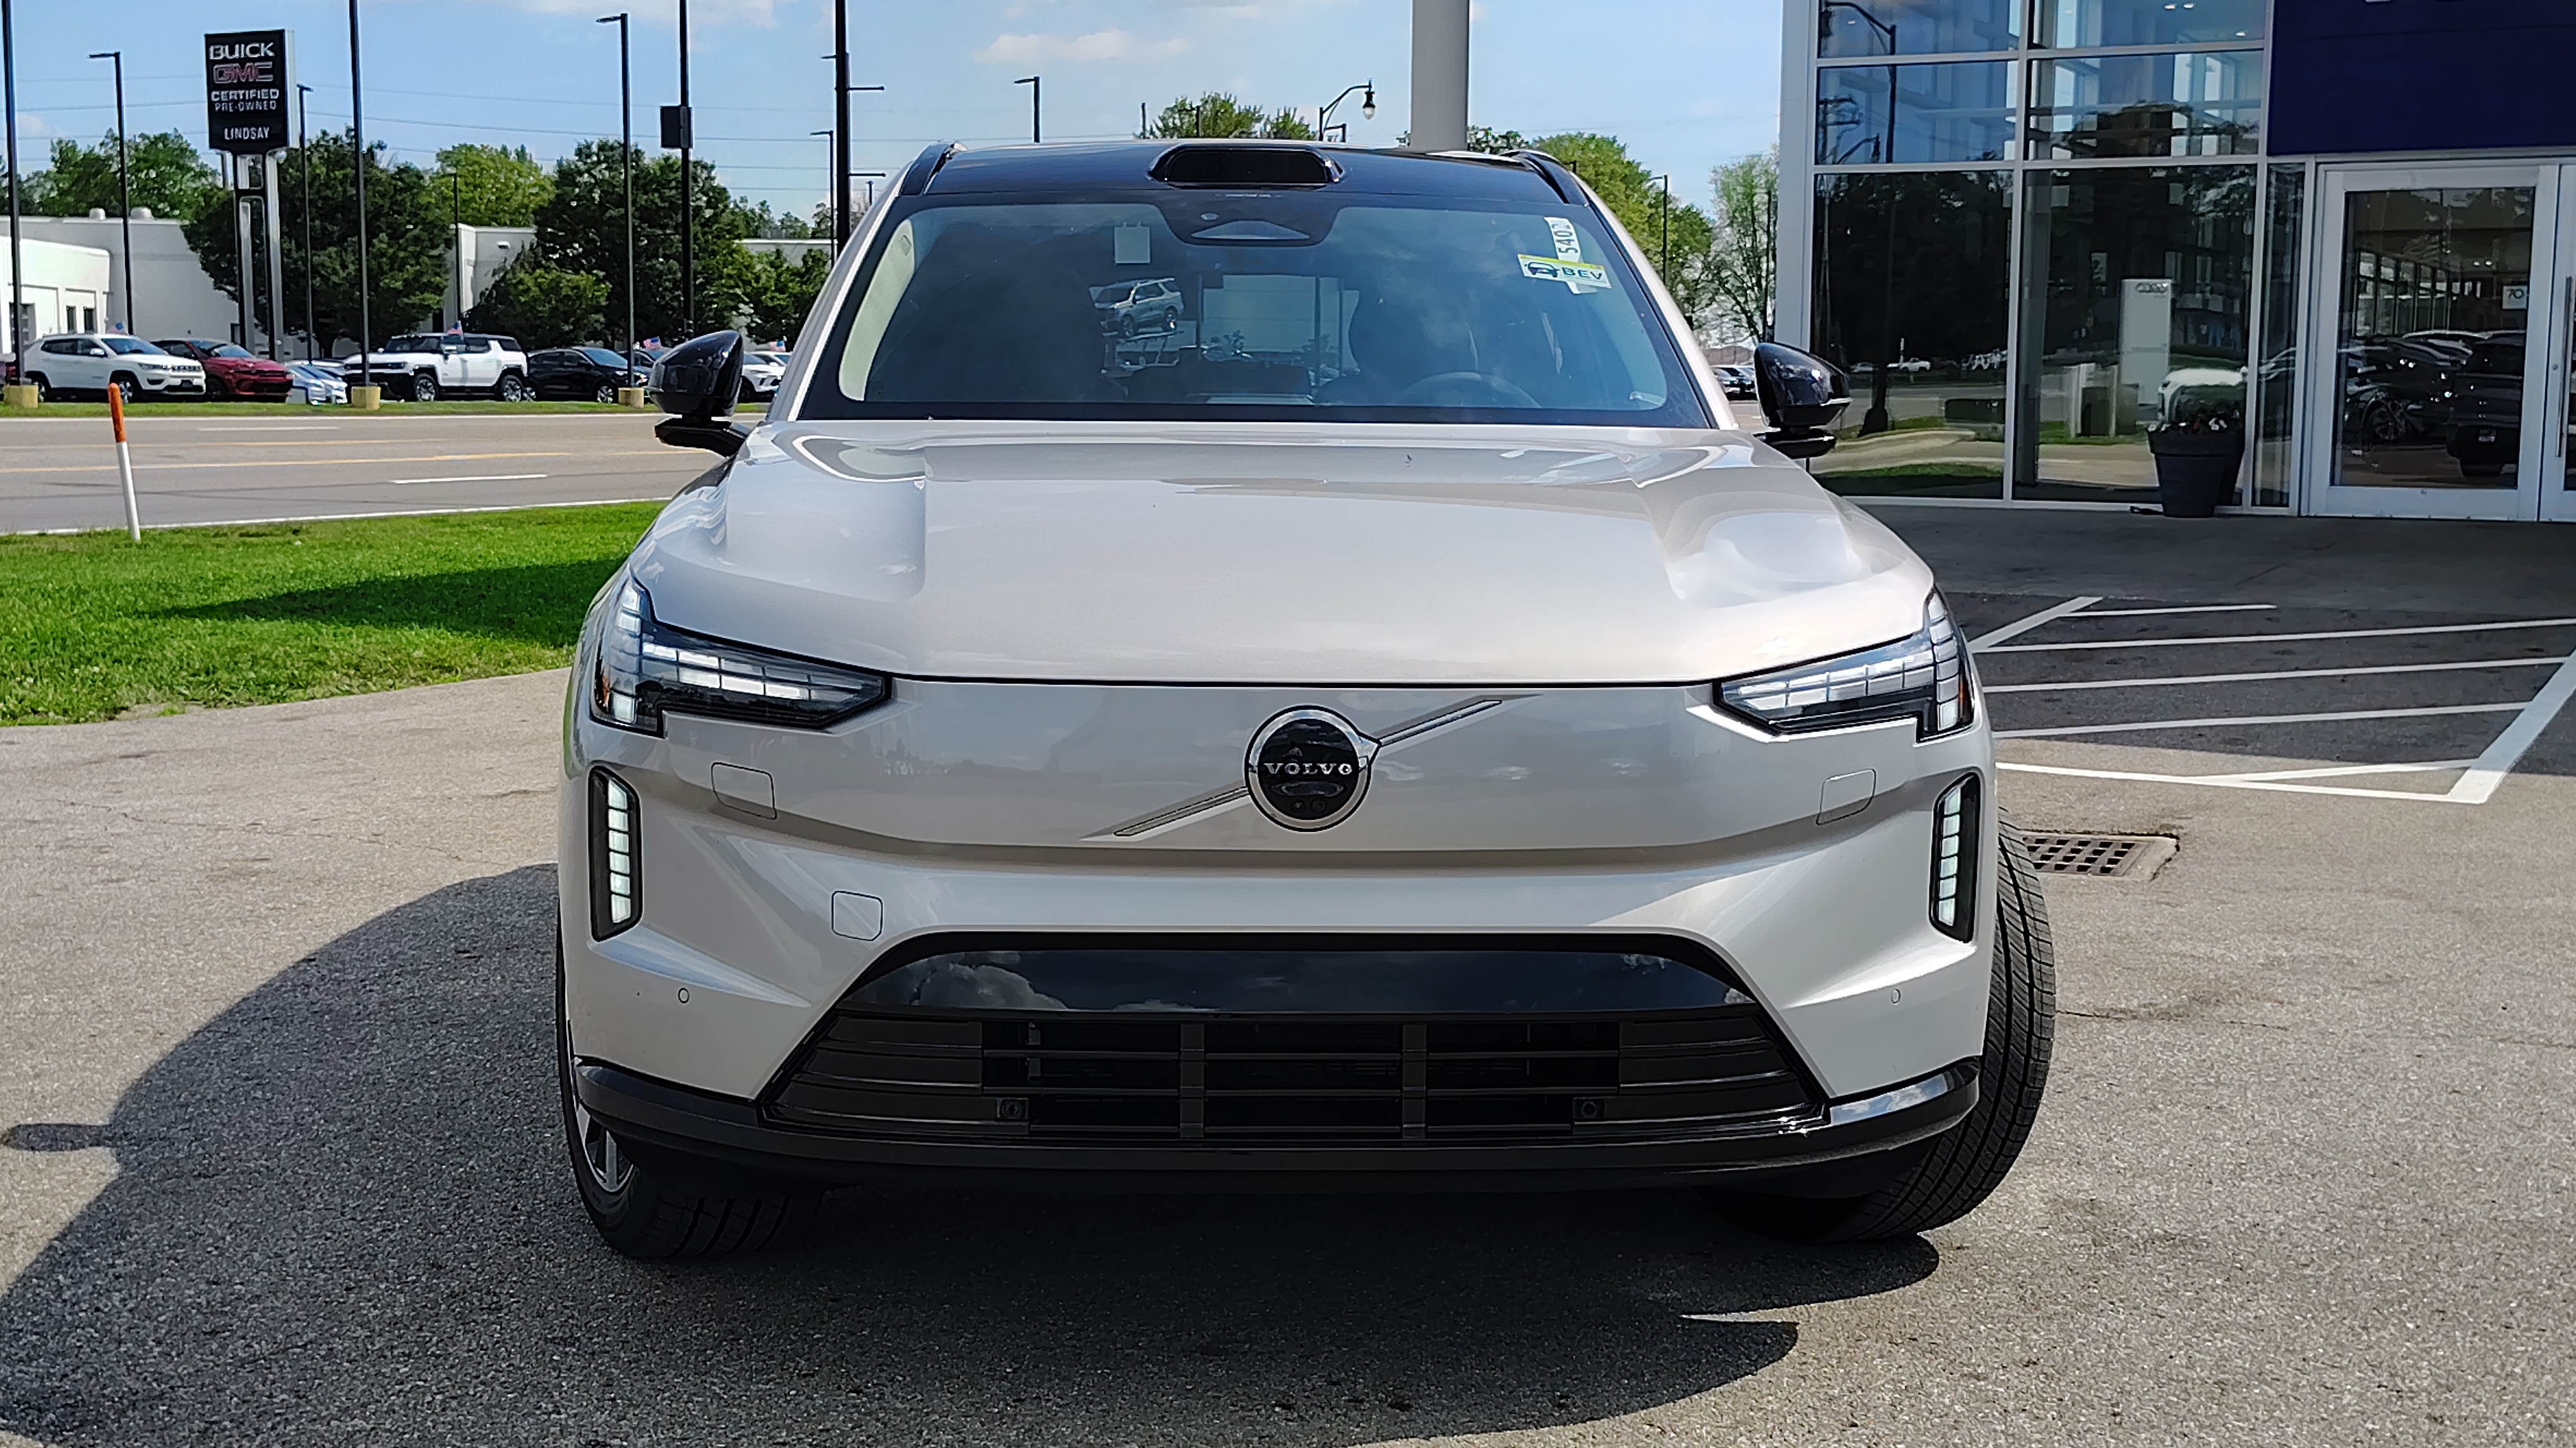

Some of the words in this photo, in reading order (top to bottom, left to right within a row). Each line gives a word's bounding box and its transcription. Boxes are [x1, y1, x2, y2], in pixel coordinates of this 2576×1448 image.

[208, 42, 275, 59] BUICK
[213, 62, 273, 83] GMC
[211, 88, 279, 101] CERTIFIED
[215, 100, 277, 112] PRE-OWNED
[224, 127, 270, 140] LINDSAY
[1561, 267, 1602, 280] BEV
[1263, 763, 1352, 774] VOLVO
